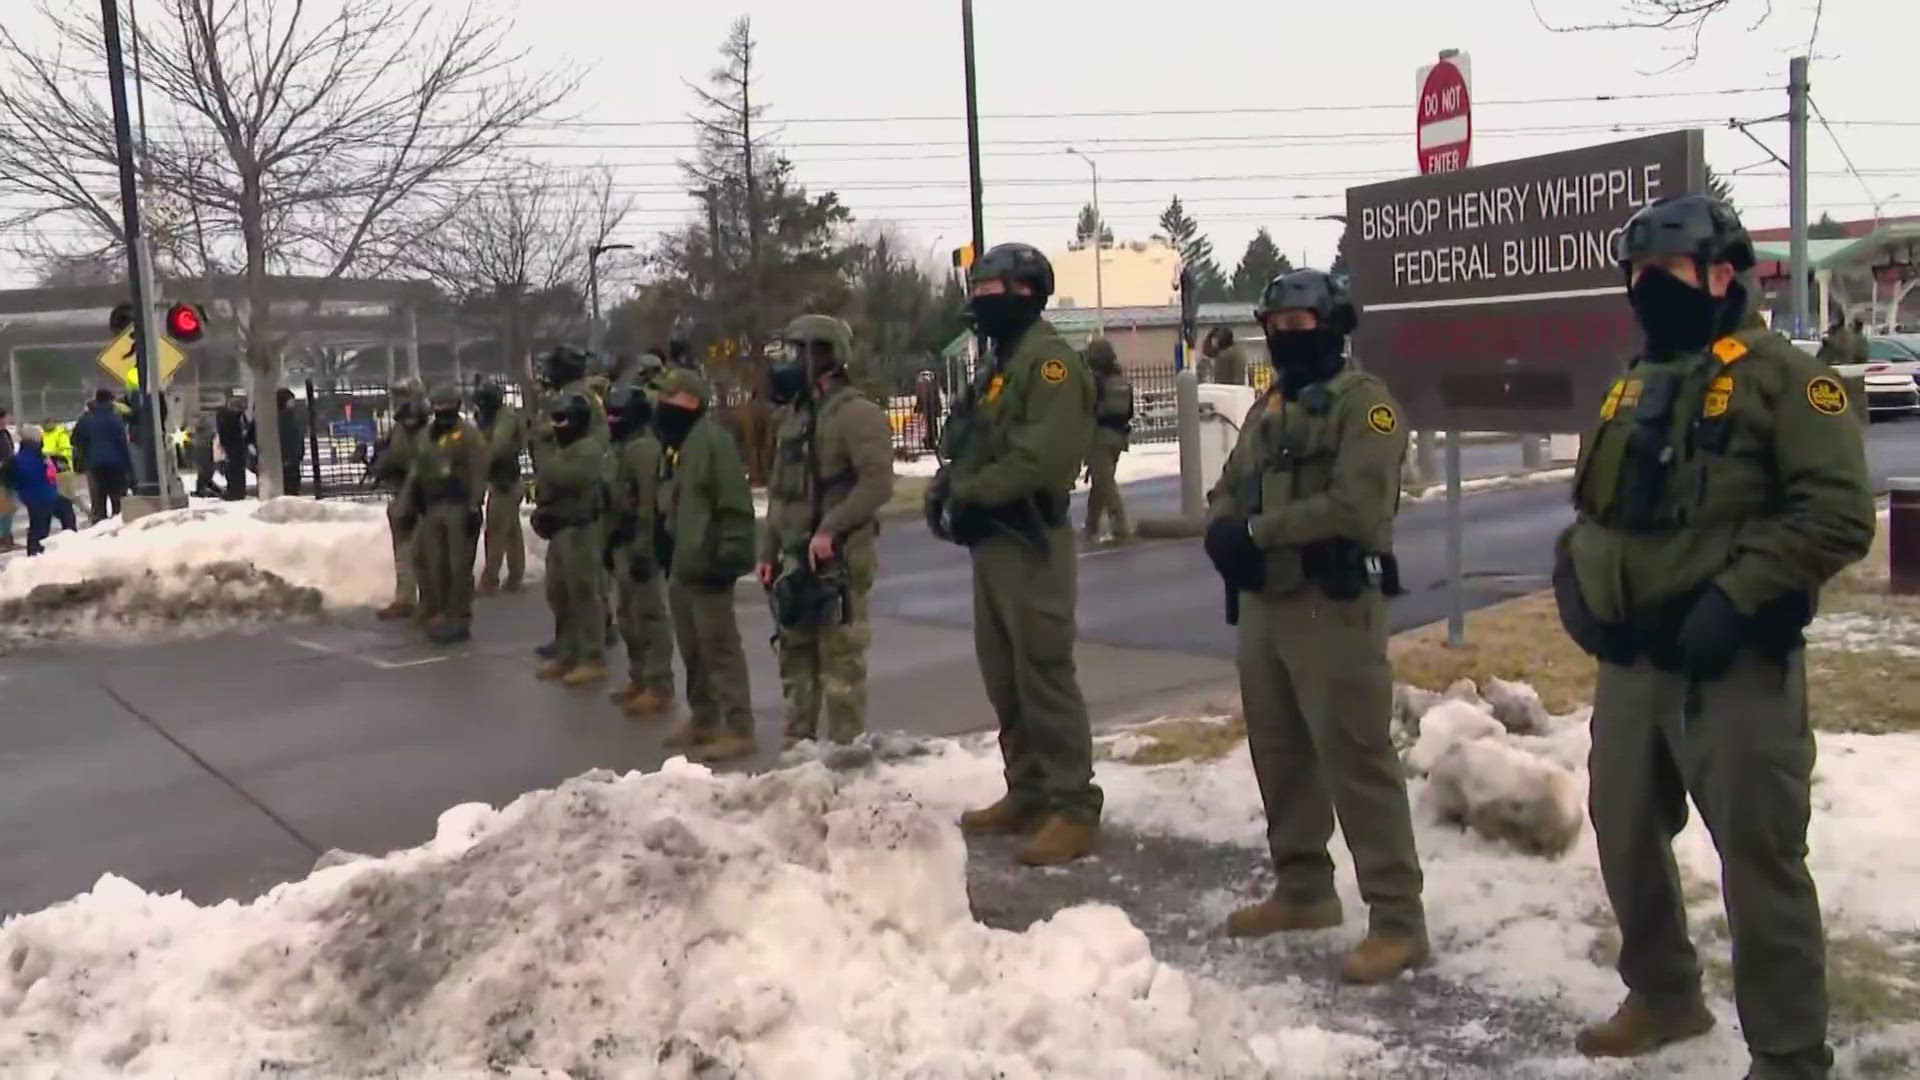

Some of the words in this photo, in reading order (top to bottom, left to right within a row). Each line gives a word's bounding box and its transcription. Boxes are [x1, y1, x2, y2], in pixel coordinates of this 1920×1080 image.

[1424, 93, 1439, 117] DO
[1442, 85, 1461, 113] NOT
[1428, 150, 1460, 175] ENTER
[1362, 198, 1441, 241] BISHOP
[1448, 183, 1530, 231] HENRY
[1537, 162, 1661, 220] WHIPPLE
[1394, 242, 1497, 288] FEDERAL
